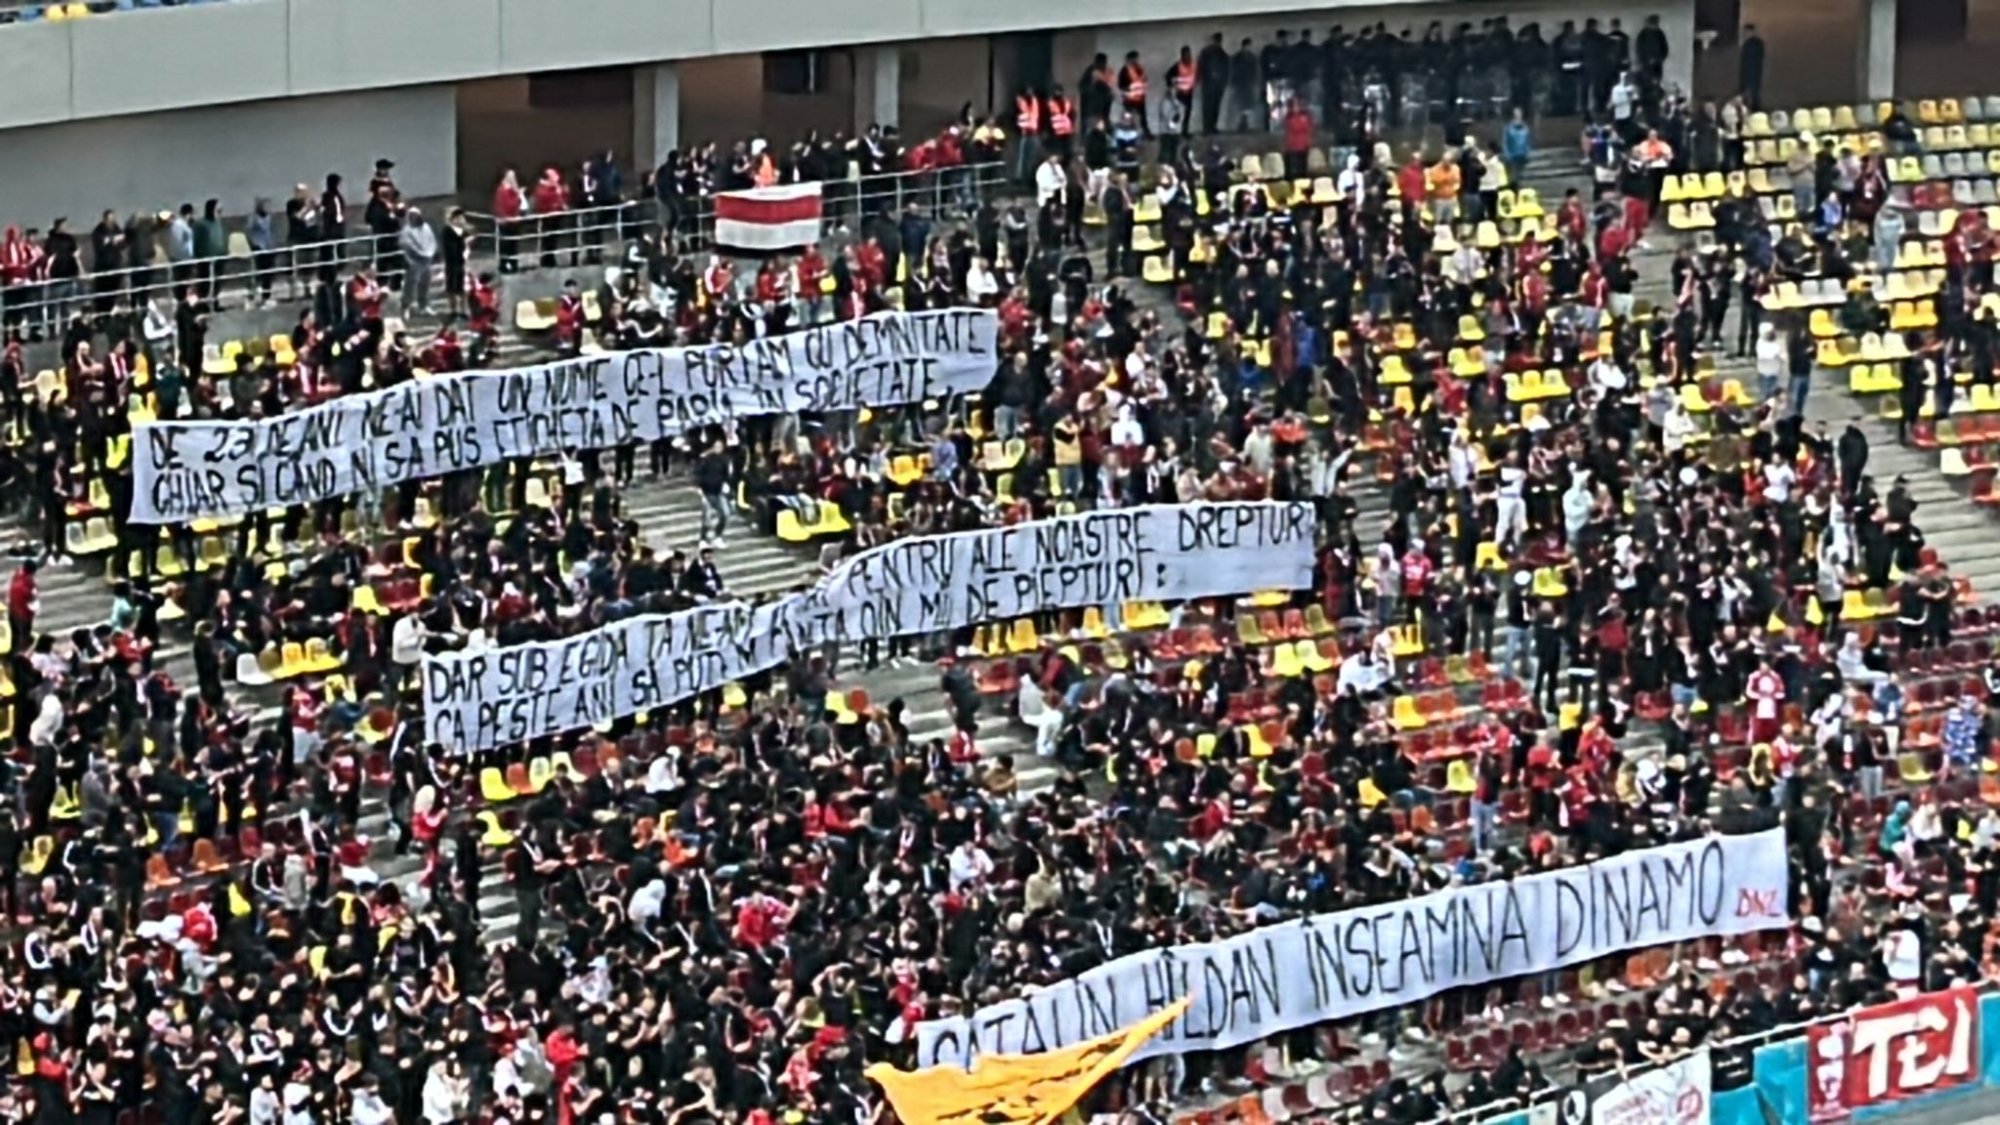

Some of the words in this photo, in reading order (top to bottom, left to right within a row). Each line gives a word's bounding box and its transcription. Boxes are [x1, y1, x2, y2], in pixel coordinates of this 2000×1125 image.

[204, 426, 254, 463] 23
[434, 375, 482, 428] DAT
[805, 328, 833, 368] CU
[434, 427, 481, 467] PUS
[428, 657, 487, 704] DAR
[499, 648, 548, 694] SUB
[848, 538, 955, 597] PENTRU
[970, 529, 1017, 574] ALE
[1036, 511, 1154, 565] NOASTRE
[478, 687, 561, 749] PESTE
[1556, 840, 1725, 958] DINAMO
